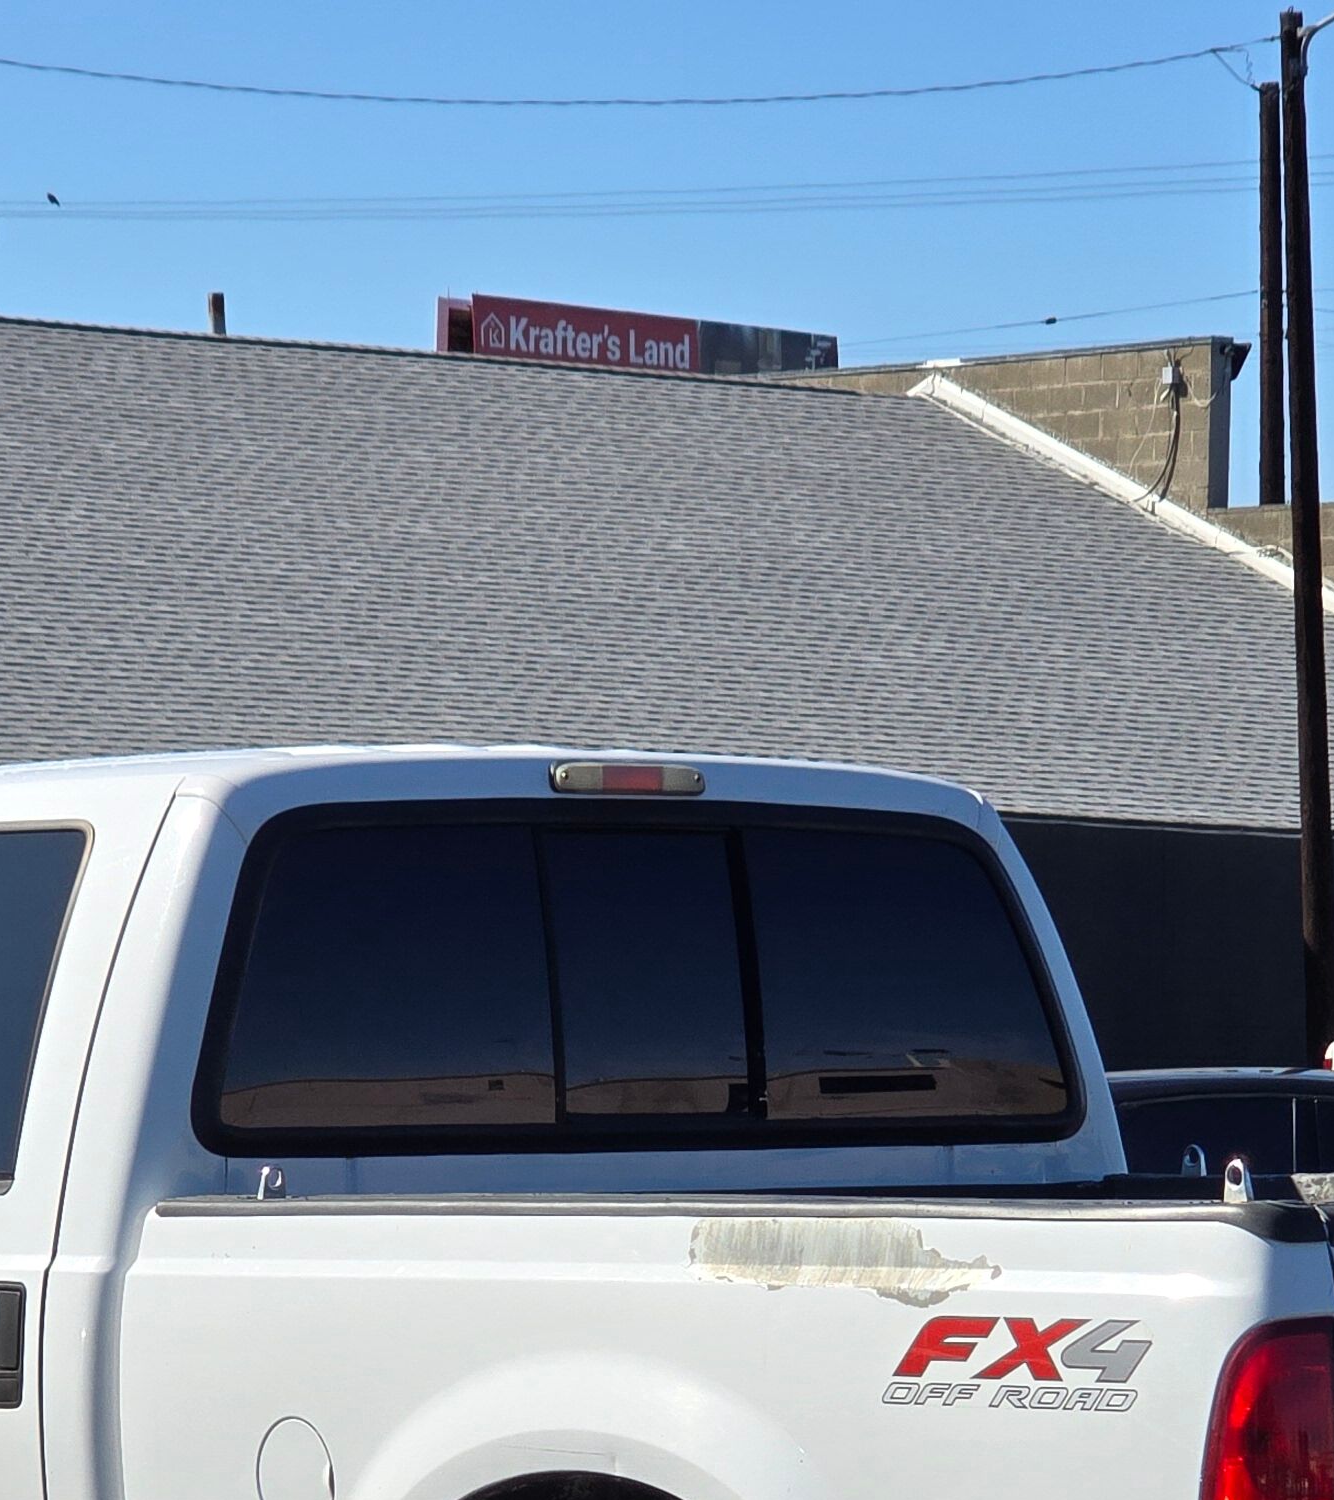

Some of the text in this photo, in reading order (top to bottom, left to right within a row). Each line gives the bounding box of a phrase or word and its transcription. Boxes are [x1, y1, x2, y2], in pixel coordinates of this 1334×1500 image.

[509, 315, 690, 369] Krafter's Land
[892, 1315, 1153, 1383] FX4
[881, 1382, 1138, 1412] OFF ROAD
